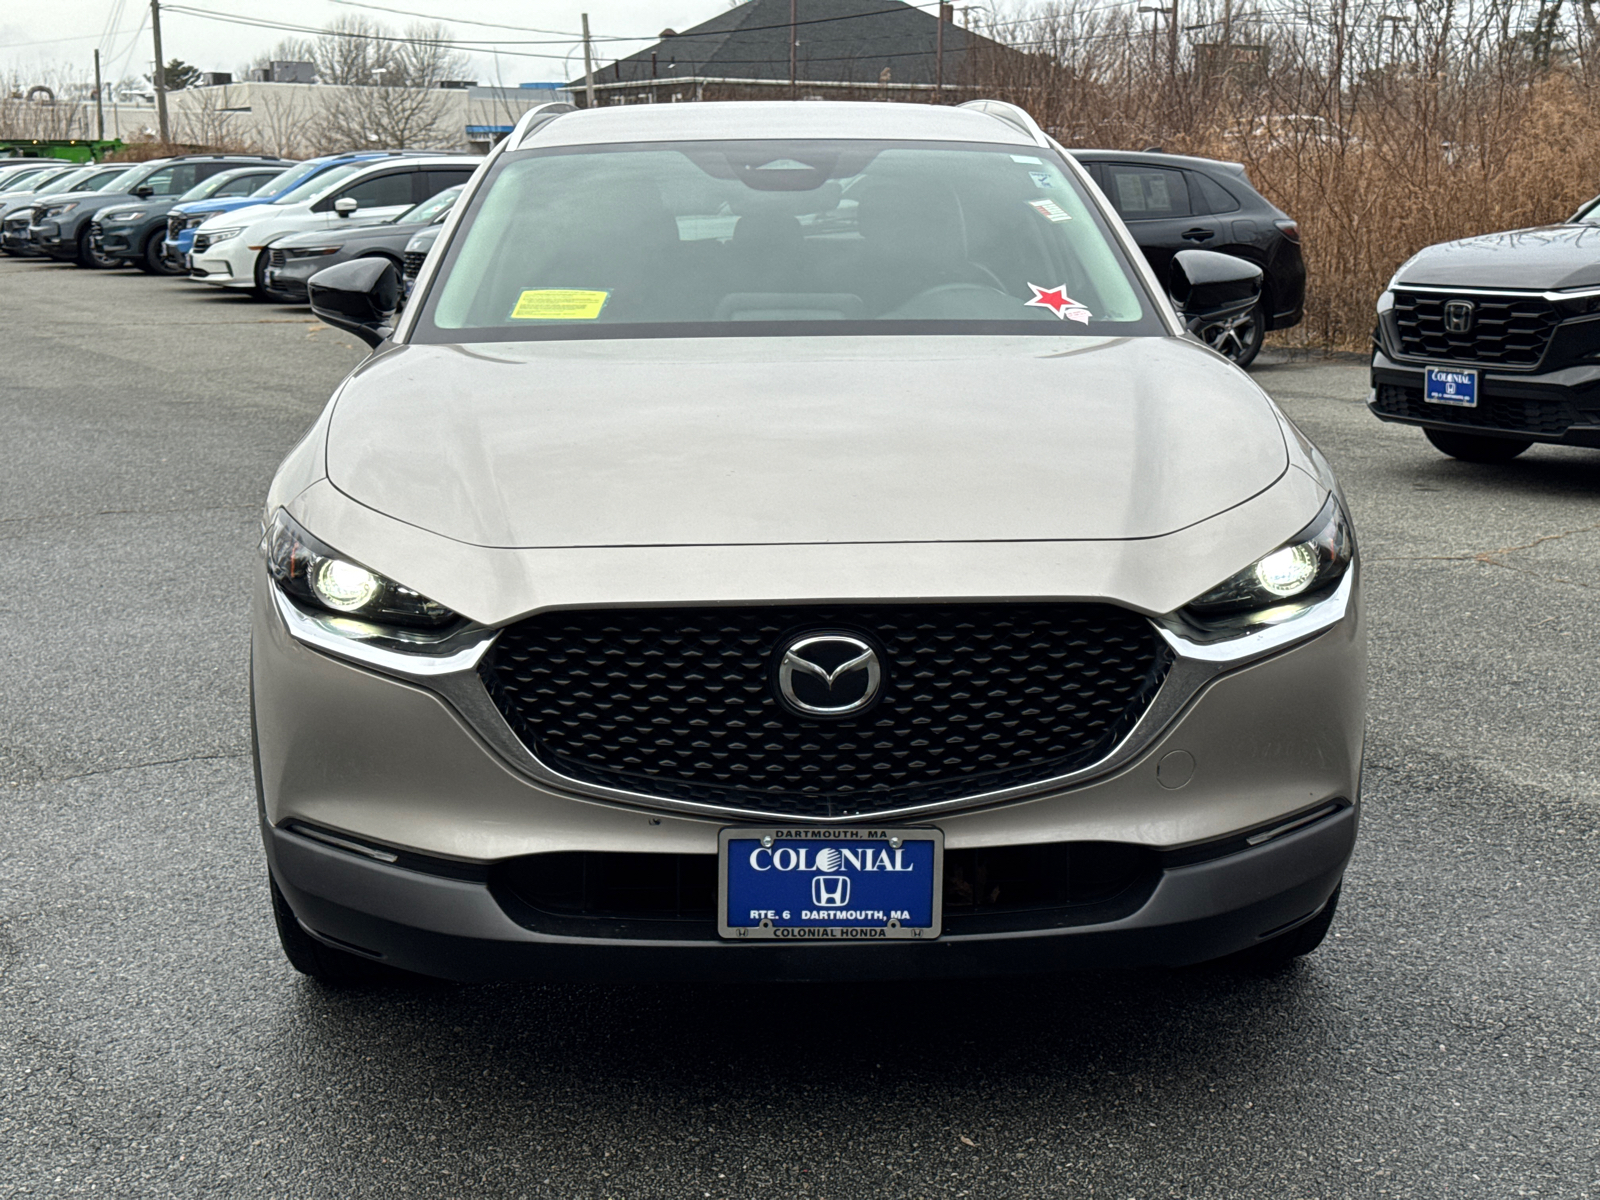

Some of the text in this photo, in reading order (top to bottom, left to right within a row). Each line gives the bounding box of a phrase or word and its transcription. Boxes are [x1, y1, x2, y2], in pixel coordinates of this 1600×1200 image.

[775, 830, 887, 839] DARTMOUTH, MA
[749, 847, 914, 872] COLONIAL
[750, 910, 910, 921] RTE. 6 DARTMOUTH, MA
[773, 928, 886, 938] COLONIAL HONDA
